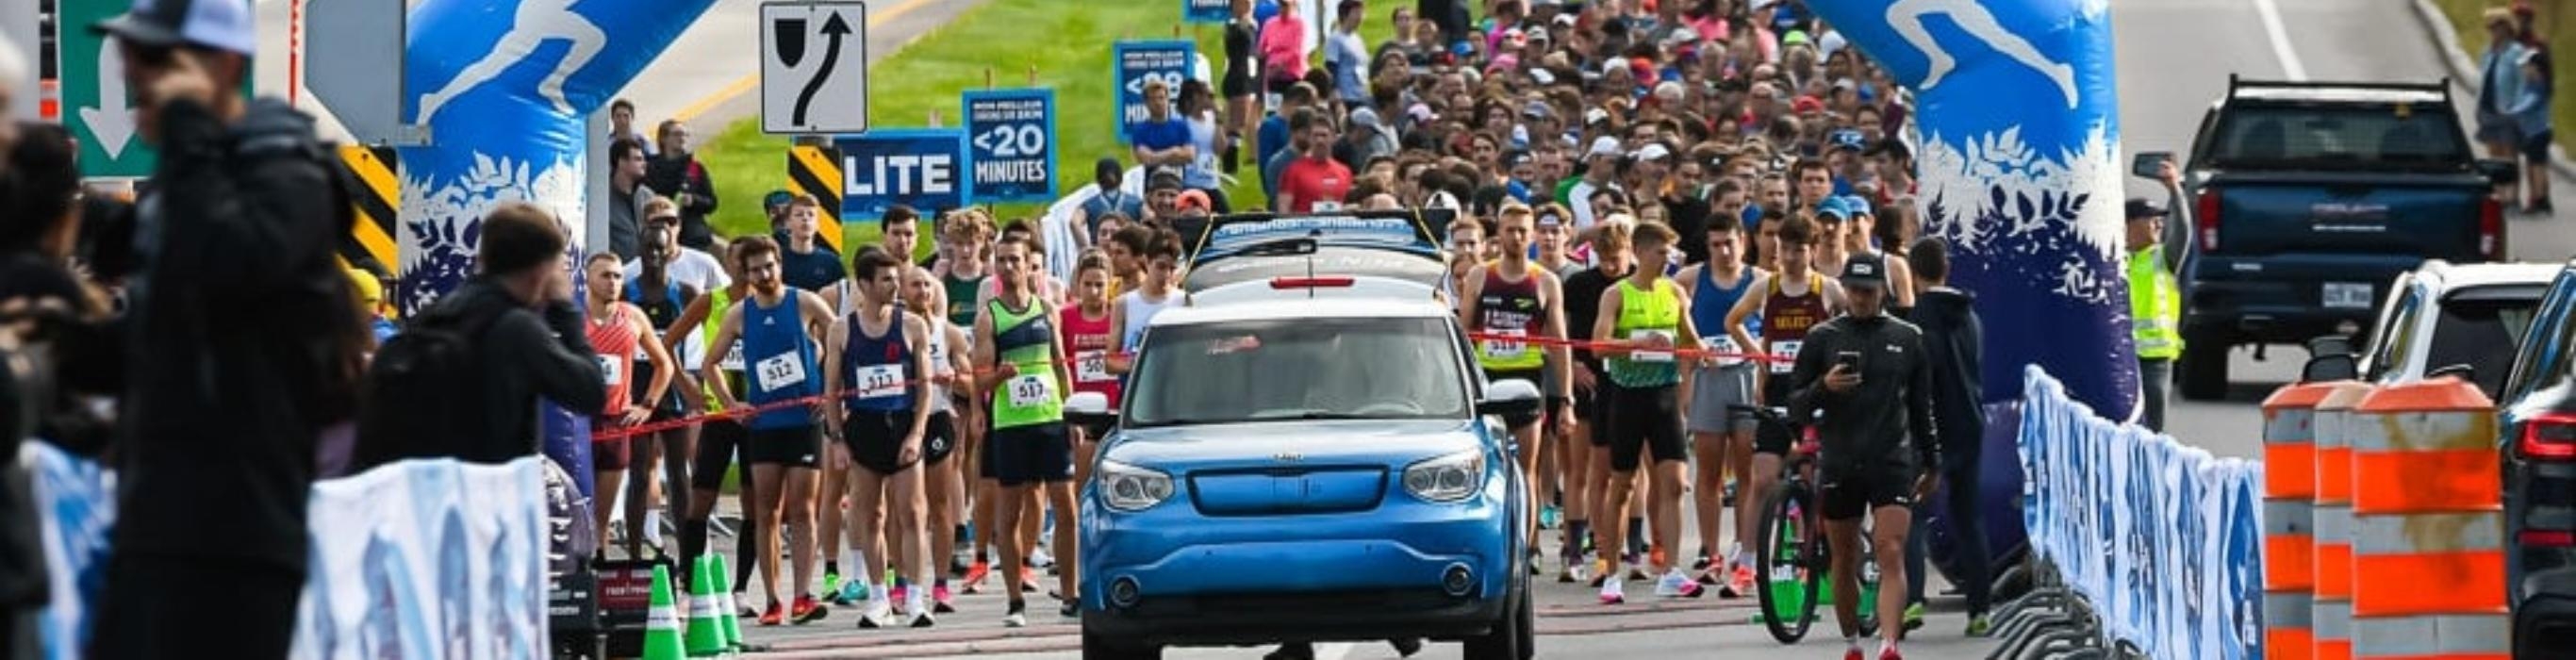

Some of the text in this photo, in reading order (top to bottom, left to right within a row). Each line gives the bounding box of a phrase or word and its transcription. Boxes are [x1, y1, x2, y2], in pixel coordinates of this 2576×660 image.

[974, 124, 1044, 157] <20
[844, 155, 950, 194] LITE
[975, 158, 1046, 184] MINUTES
